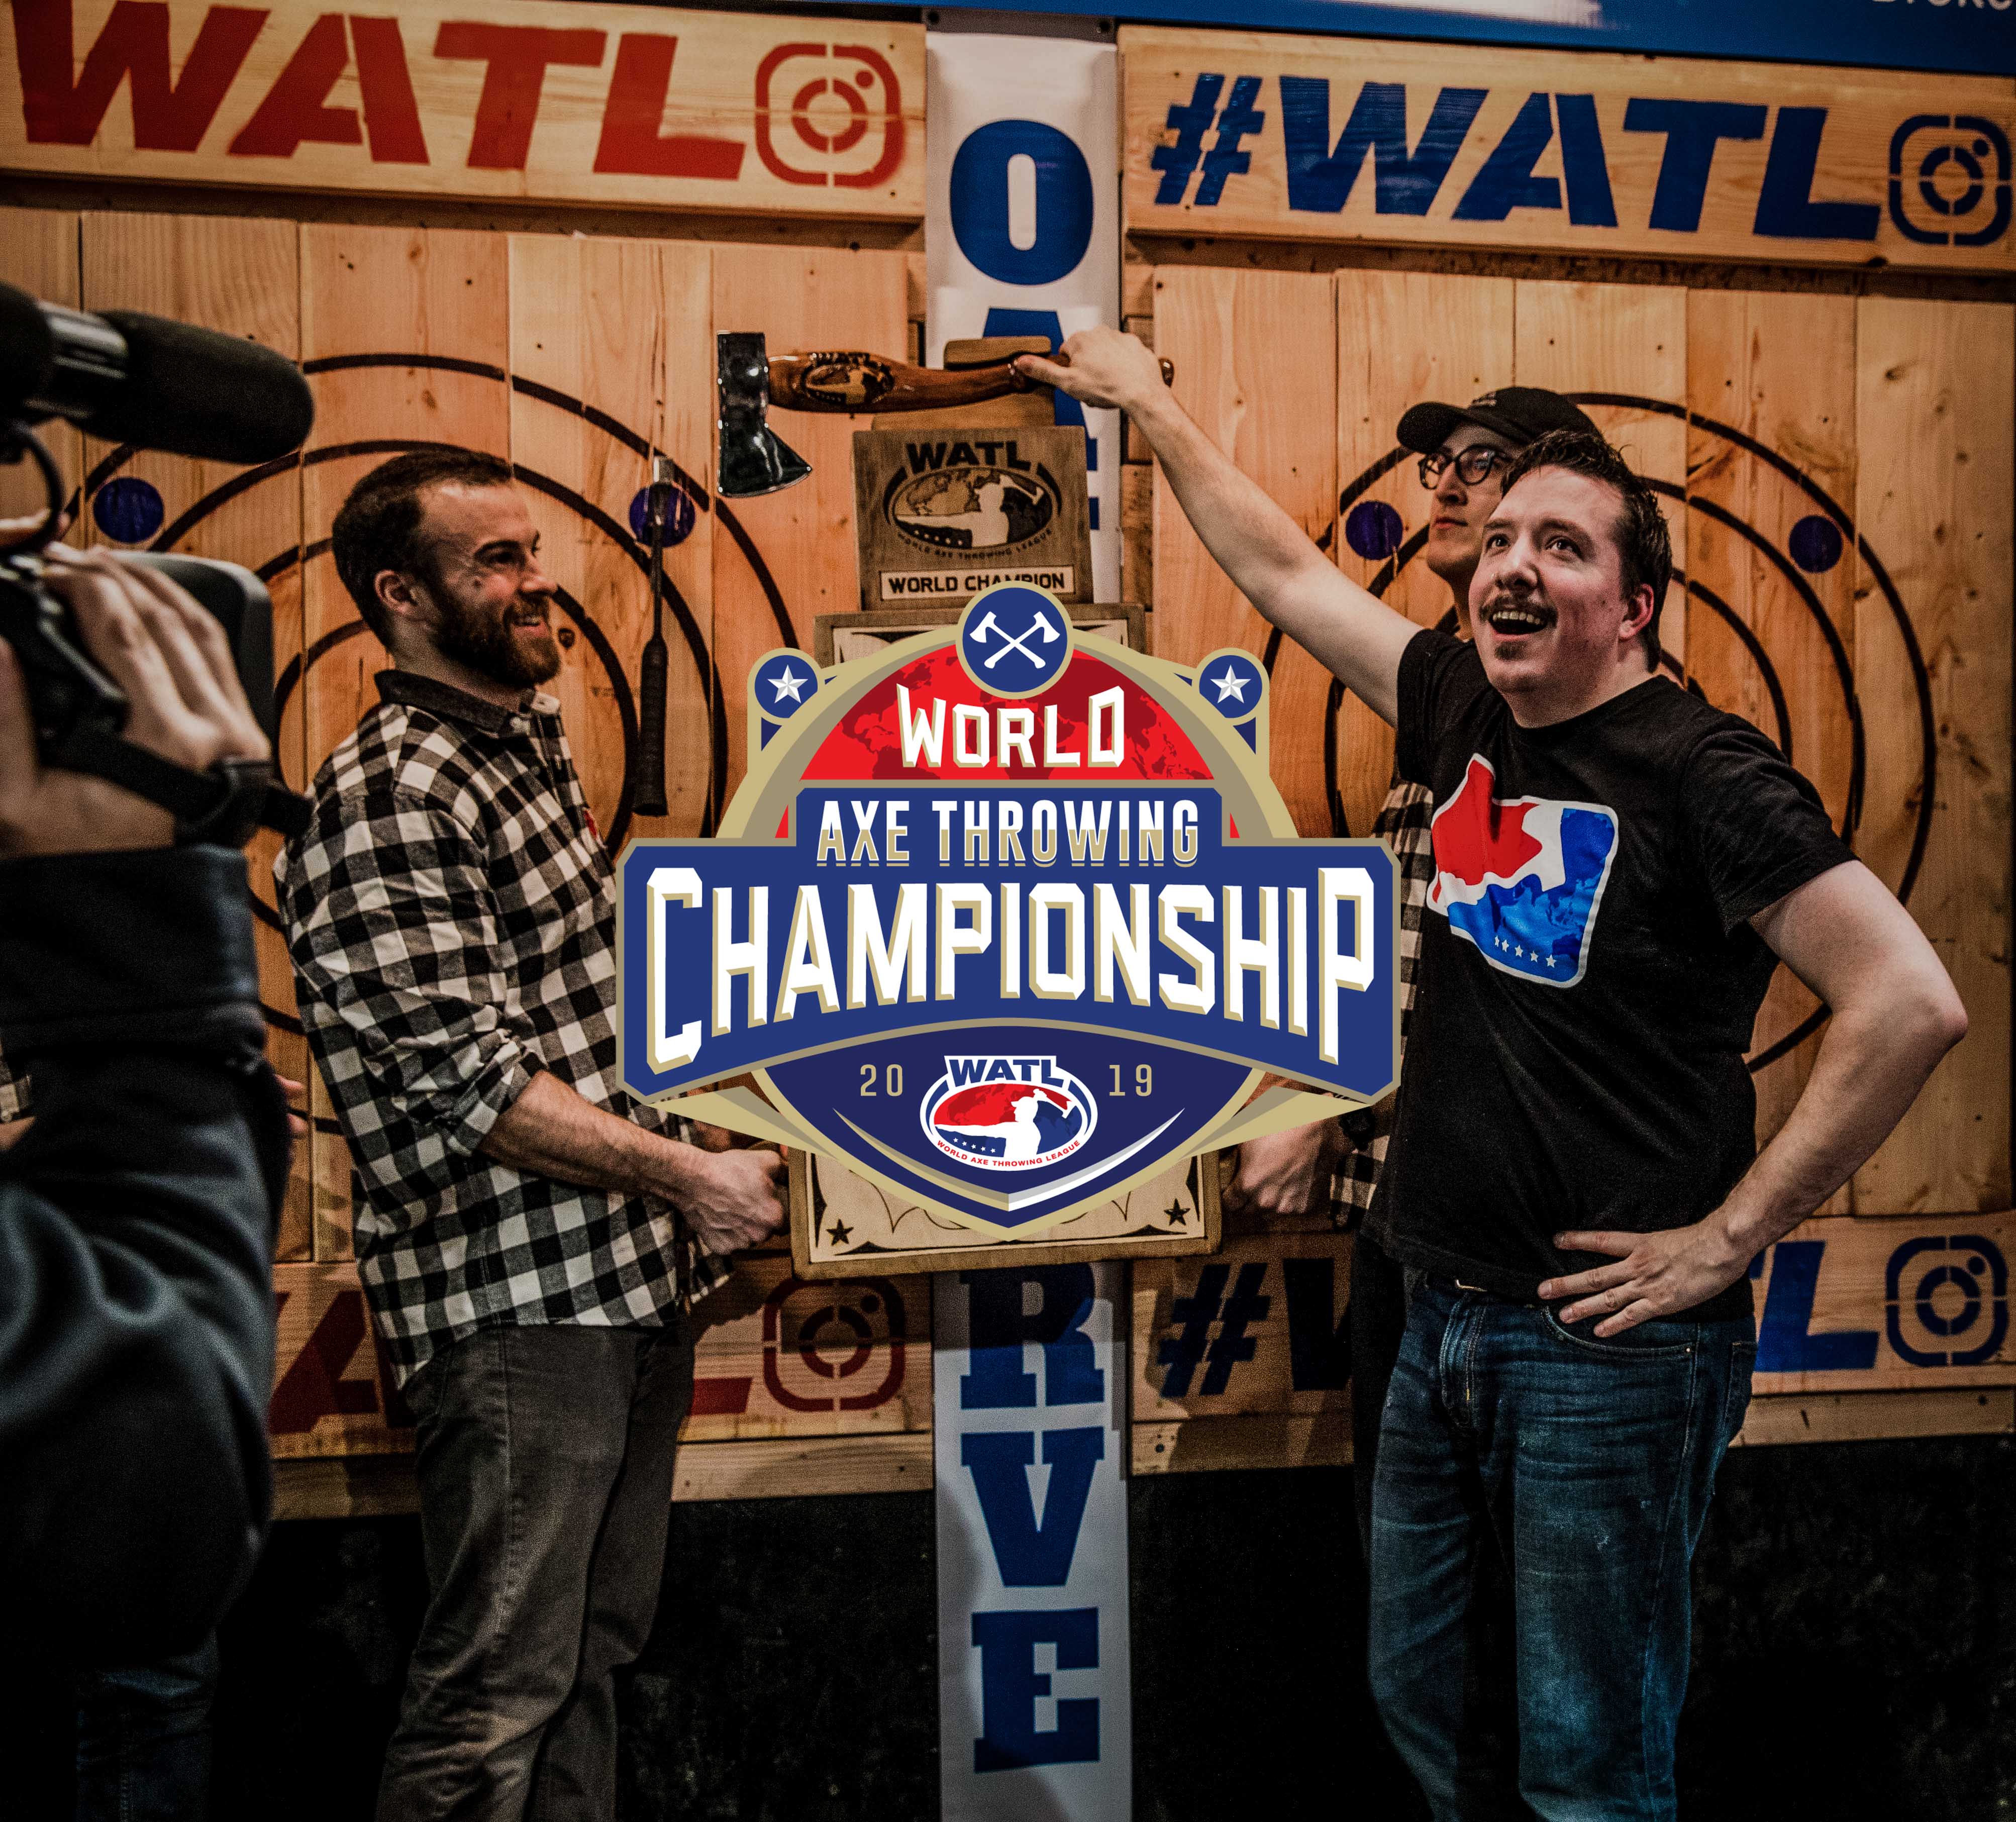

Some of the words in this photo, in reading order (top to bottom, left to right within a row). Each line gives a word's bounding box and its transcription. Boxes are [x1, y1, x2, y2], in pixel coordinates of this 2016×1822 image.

[13, 0, 745, 181] WATL
[1152, 73, 1881, 241] #WATL
[908, 441, 1032, 473] WATL
[889, 577, 957, 593] WORLD
